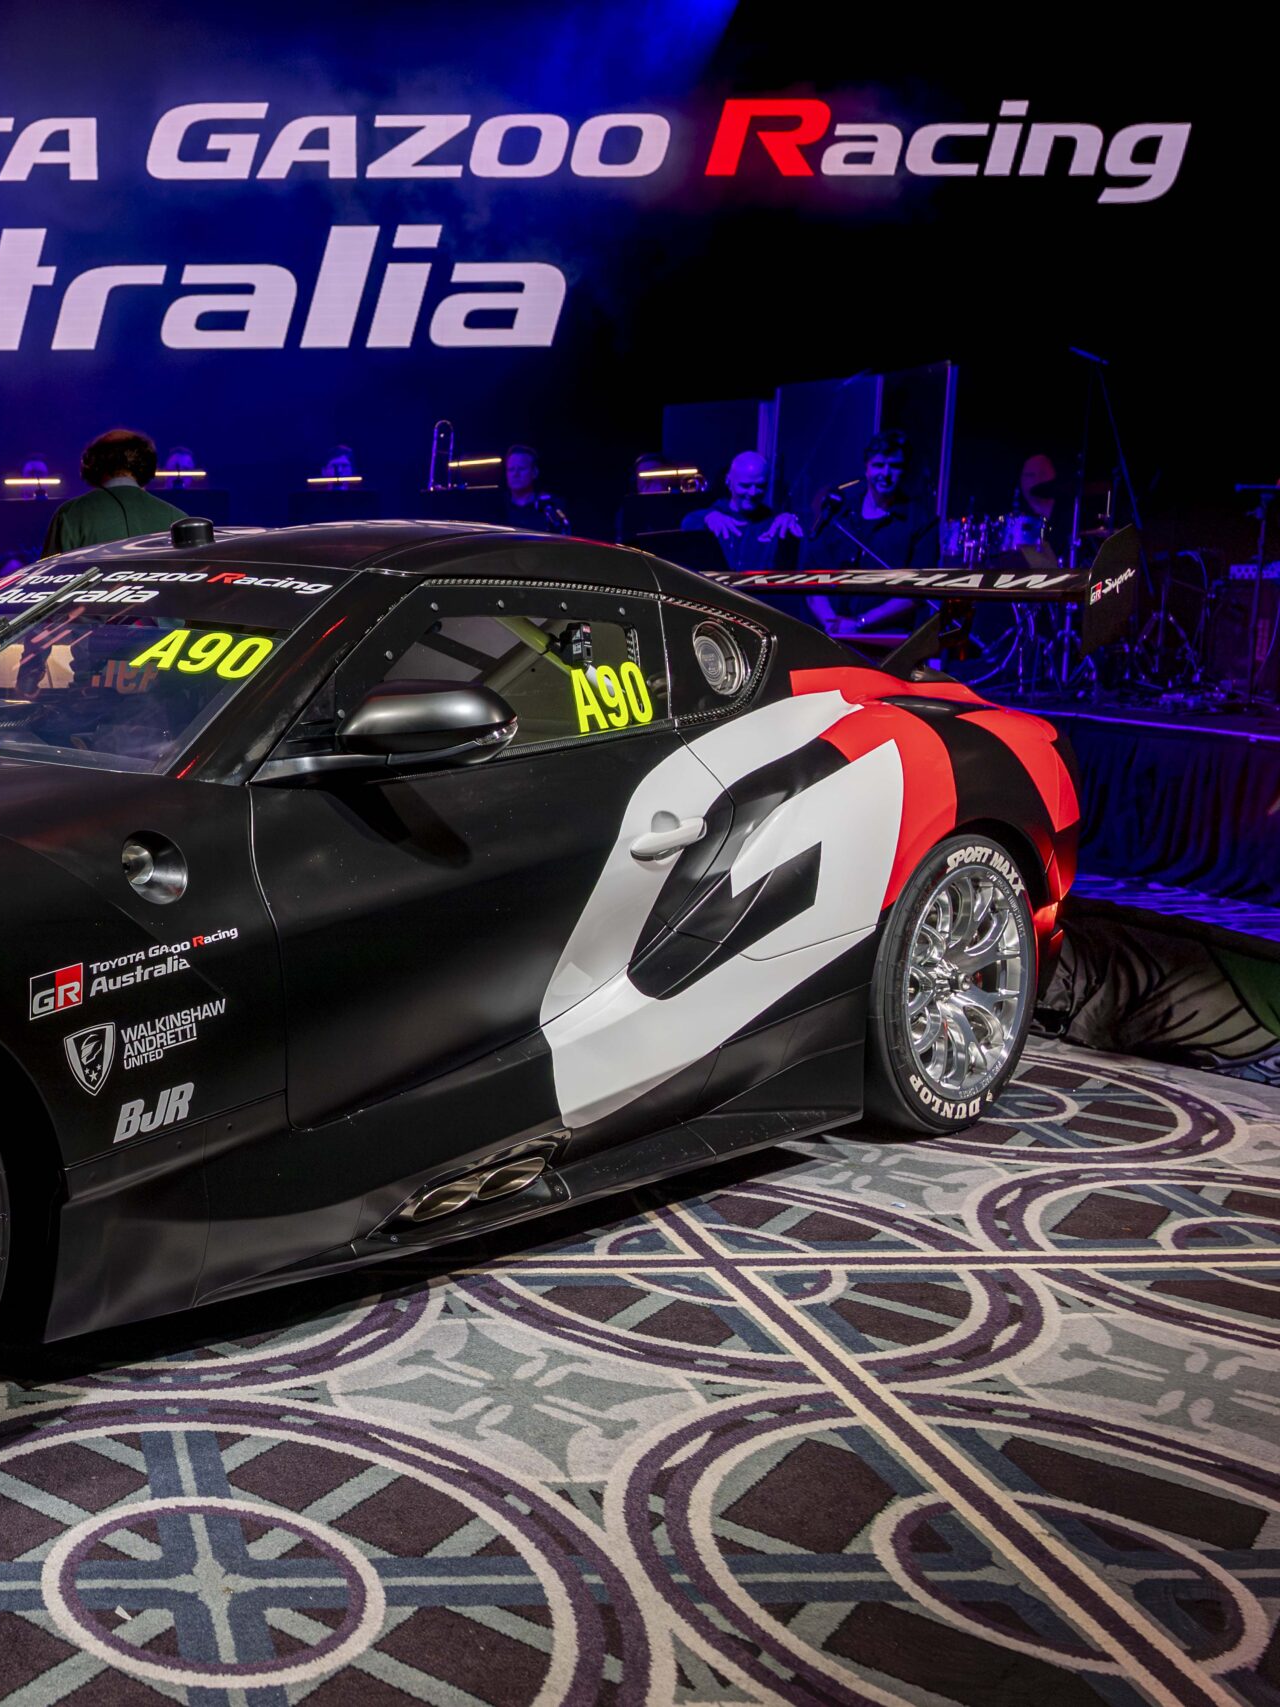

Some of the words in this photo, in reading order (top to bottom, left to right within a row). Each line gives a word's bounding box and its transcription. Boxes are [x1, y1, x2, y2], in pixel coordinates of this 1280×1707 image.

[145, 102, 671, 181] GAZOO
[704, 98, 1193, 204] Racing
[101, 570, 209, 583] GAZOO
[207, 571, 334, 595] Racing
[716, 572, 1078, 590] KINSHAW
[1102, 567, 1136, 594] Supra
[128, 628, 274, 680] A90
[570, 660, 655, 735] A90
[946, 846, 993, 874] SPORT
[989, 851, 1026, 897] MAXX
[89, 951, 146, 975] TOYOTA
[148, 941, 191, 958] GAOO
[192, 927, 239, 948] Racing
[32, 980, 81, 1015] GR
[89, 954, 191, 997] Australia
[121, 998, 226, 1043] WALKINSHAW
[123, 1022, 197, 1060] ANDRETTI
[123, 1048, 164, 1070] UNITED
[112, 1081, 195, 1144] BJR
[909, 1074, 982, 1120] DUNLOP
